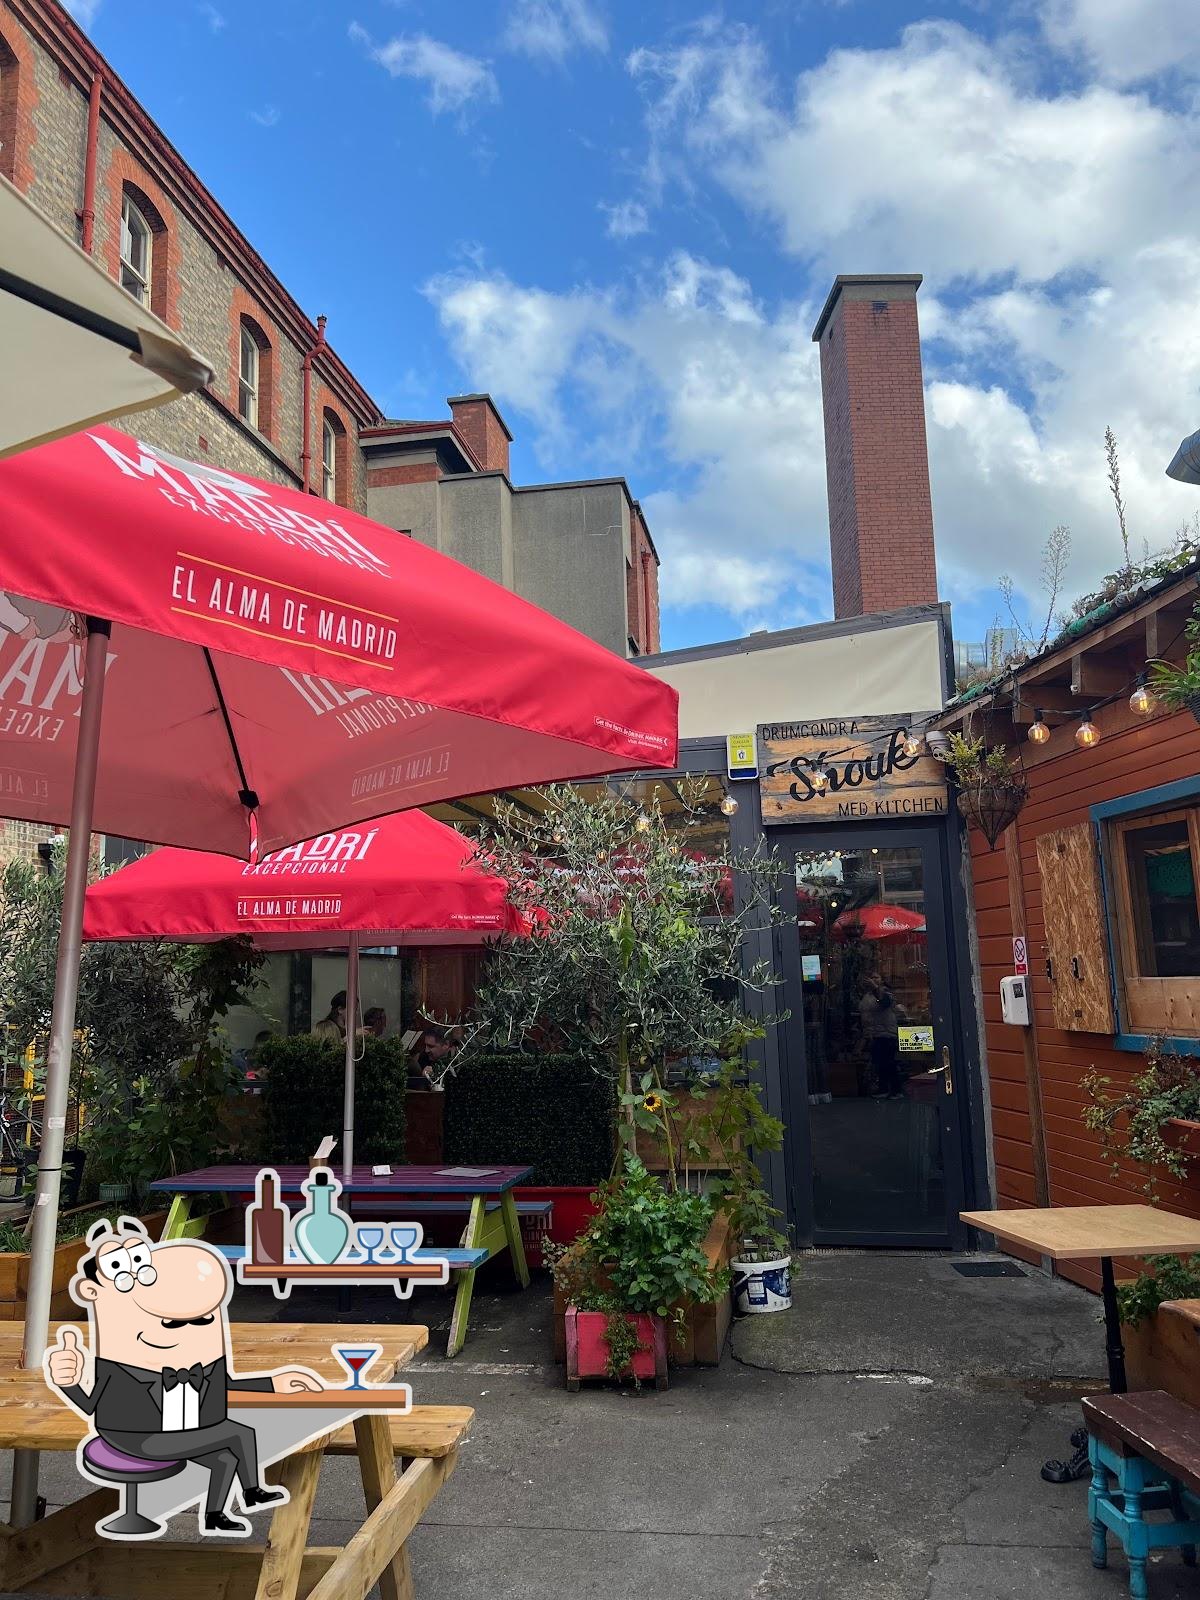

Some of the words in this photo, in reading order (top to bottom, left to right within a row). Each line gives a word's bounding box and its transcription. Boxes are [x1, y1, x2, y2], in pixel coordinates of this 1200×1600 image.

[85, 432, 390, 567] MADRÍ
[157, 487, 393, 579] EXCEPCIONAL
[171, 565, 199, 603] EL
[208, 577, 271, 624] ALMA
[282, 598, 308, 635] DE
[317, 609, 398, 660] MADRID
[762, 721, 860, 741] DRUMCONDRA
[875, 796, 944, 815] KITCHEN
[250, 828, 379, 862] ADRÍ
[242, 861, 346, 876] EXCEPCIONAL
[237, 901, 248, 916] EL
[253, 901, 281, 915] ALMA
[286, 900, 297, 914] DE
[302, 899, 342, 914] MADRID
